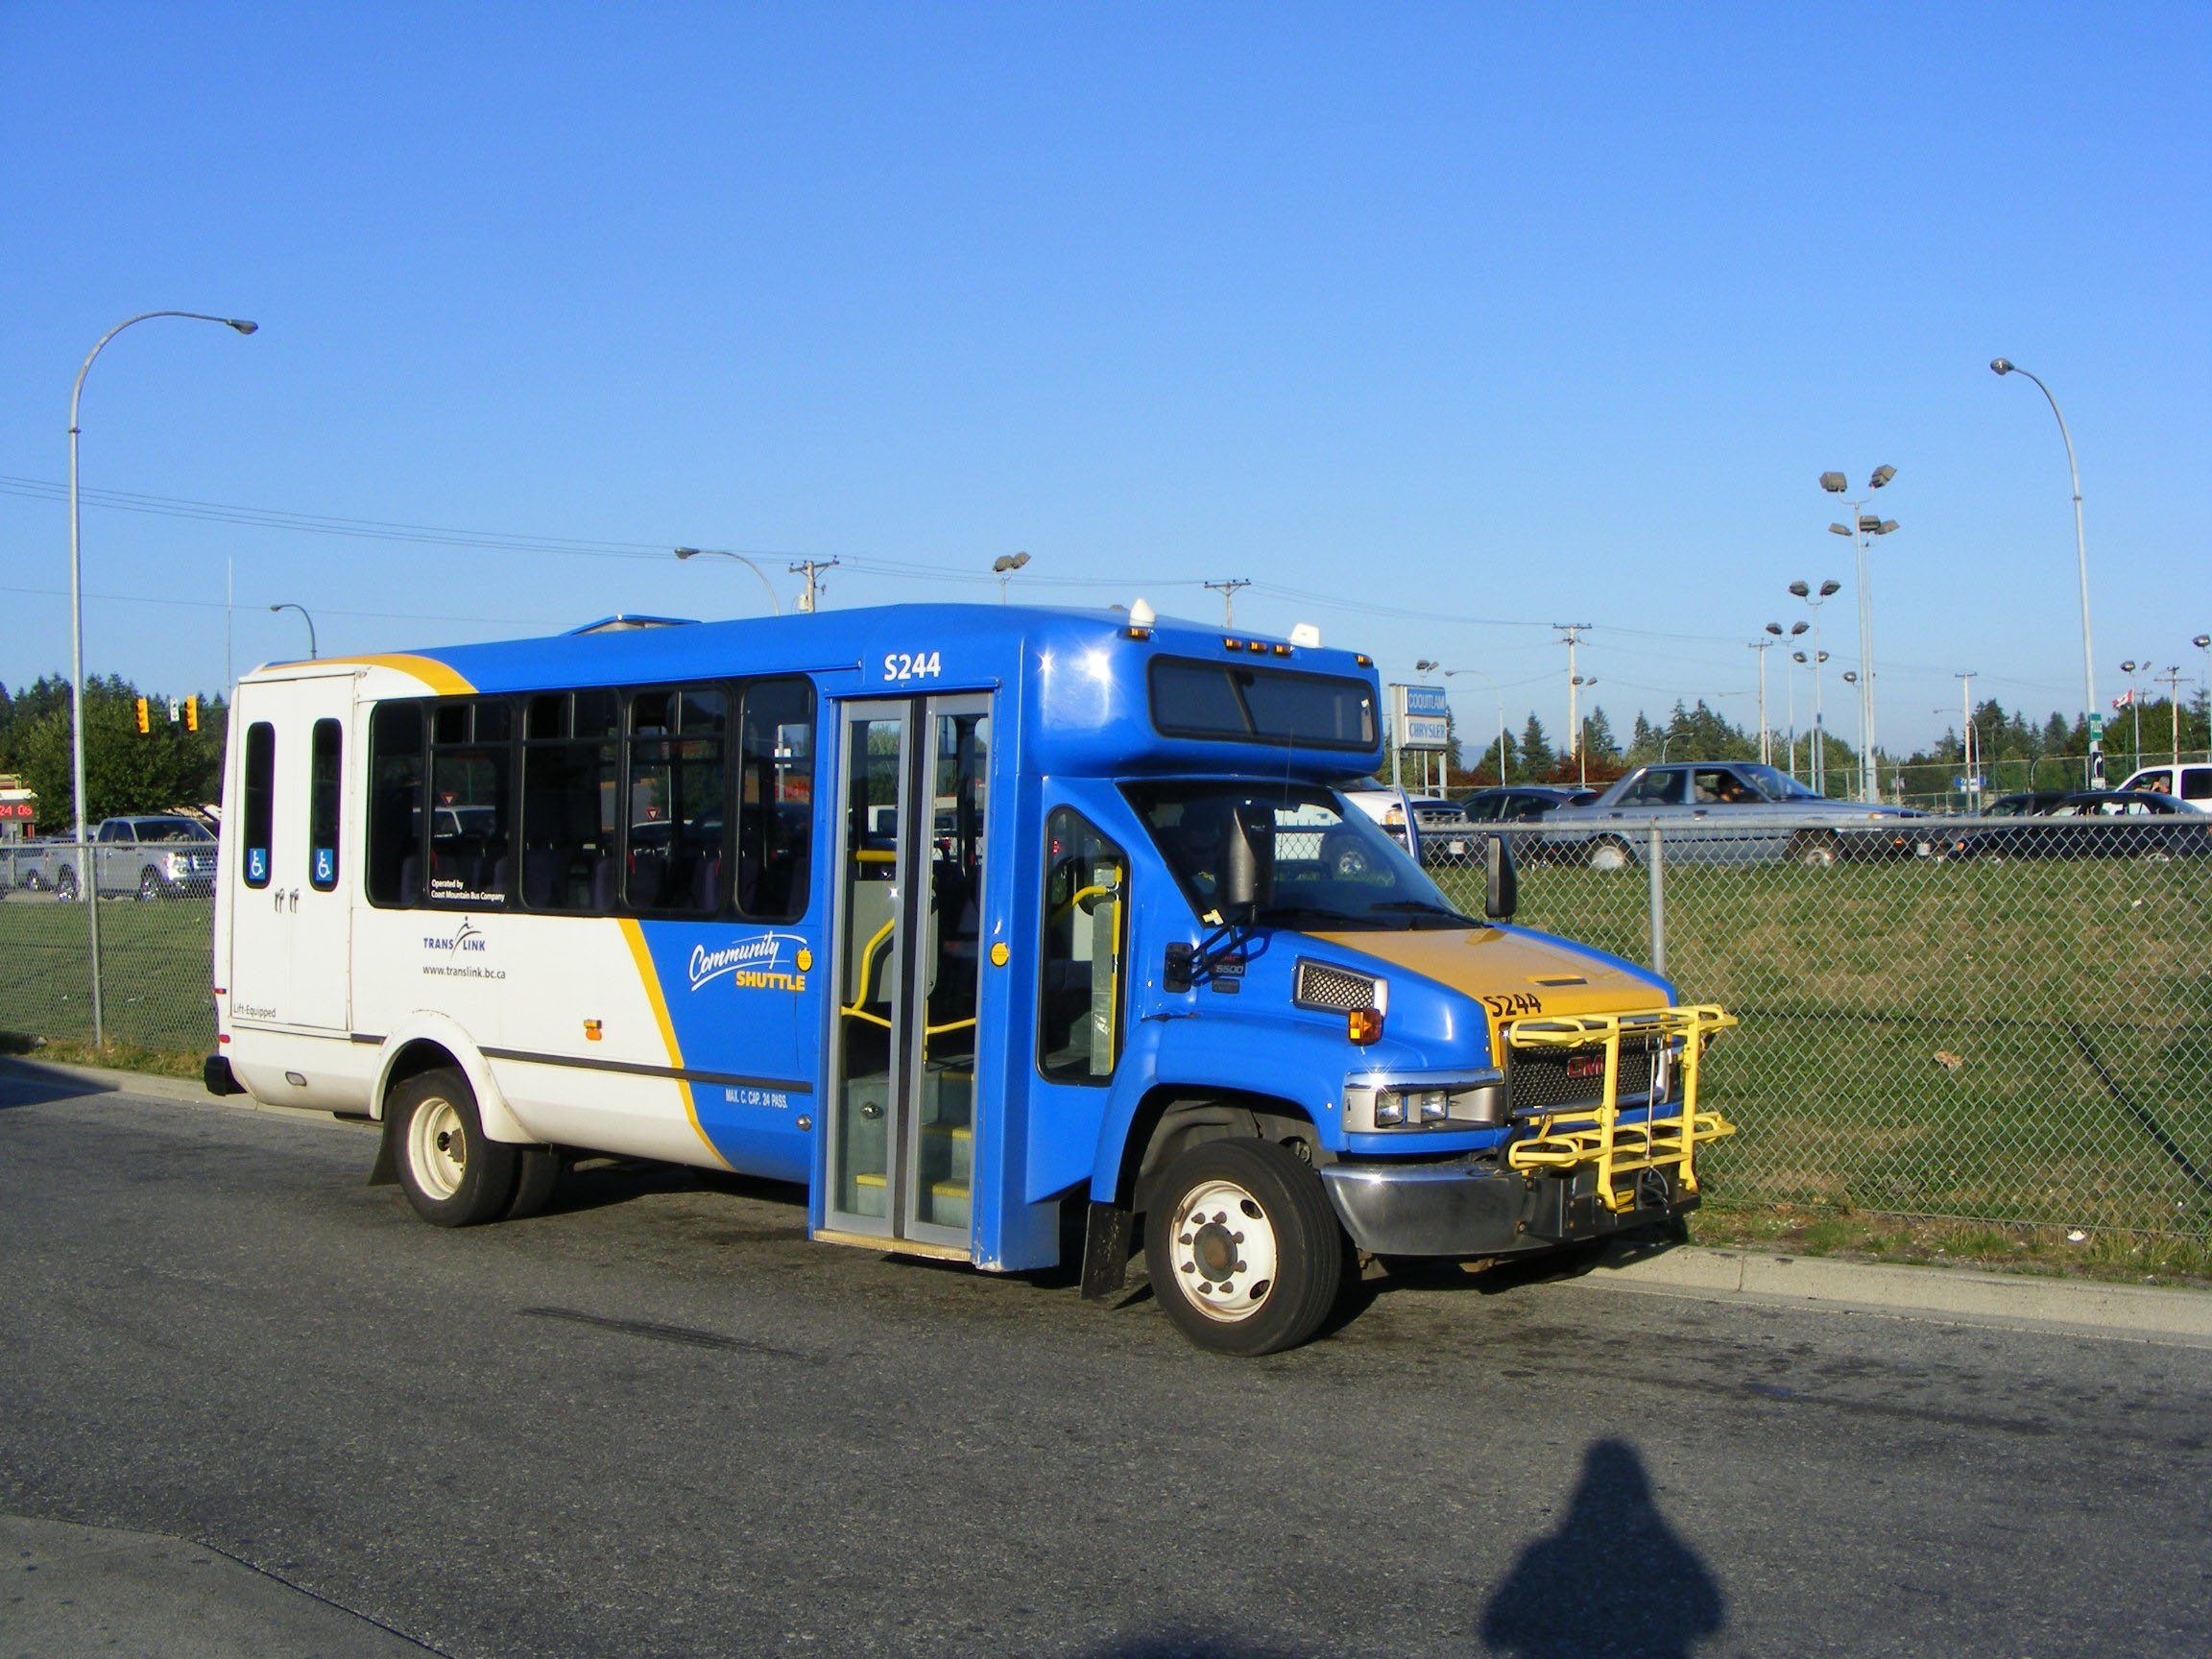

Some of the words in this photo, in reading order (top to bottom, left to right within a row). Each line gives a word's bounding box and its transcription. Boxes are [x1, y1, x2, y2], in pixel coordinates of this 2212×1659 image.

[884, 652, 941, 681] S244
[1409, 722, 1445, 738] CHRYSLER
[431, 878, 456, 889] Operated
[456, 879, 464, 889] by
[431, 890, 445, 899] Coast
[445, 891, 470, 900] Mountain
[480, 891, 505, 902] Company
[689, 930, 780, 981] Community
[422, 966, 506, 979] www.translink.bc.ca
[735, 971, 805, 991] SHUTTLE
[233, 1003, 276, 1018] Lift-Equipped
[1483, 994, 1542, 1018] S244
[1567, 1055, 1603, 1078] GM
[725, 1088, 739, 1103] MAX.
